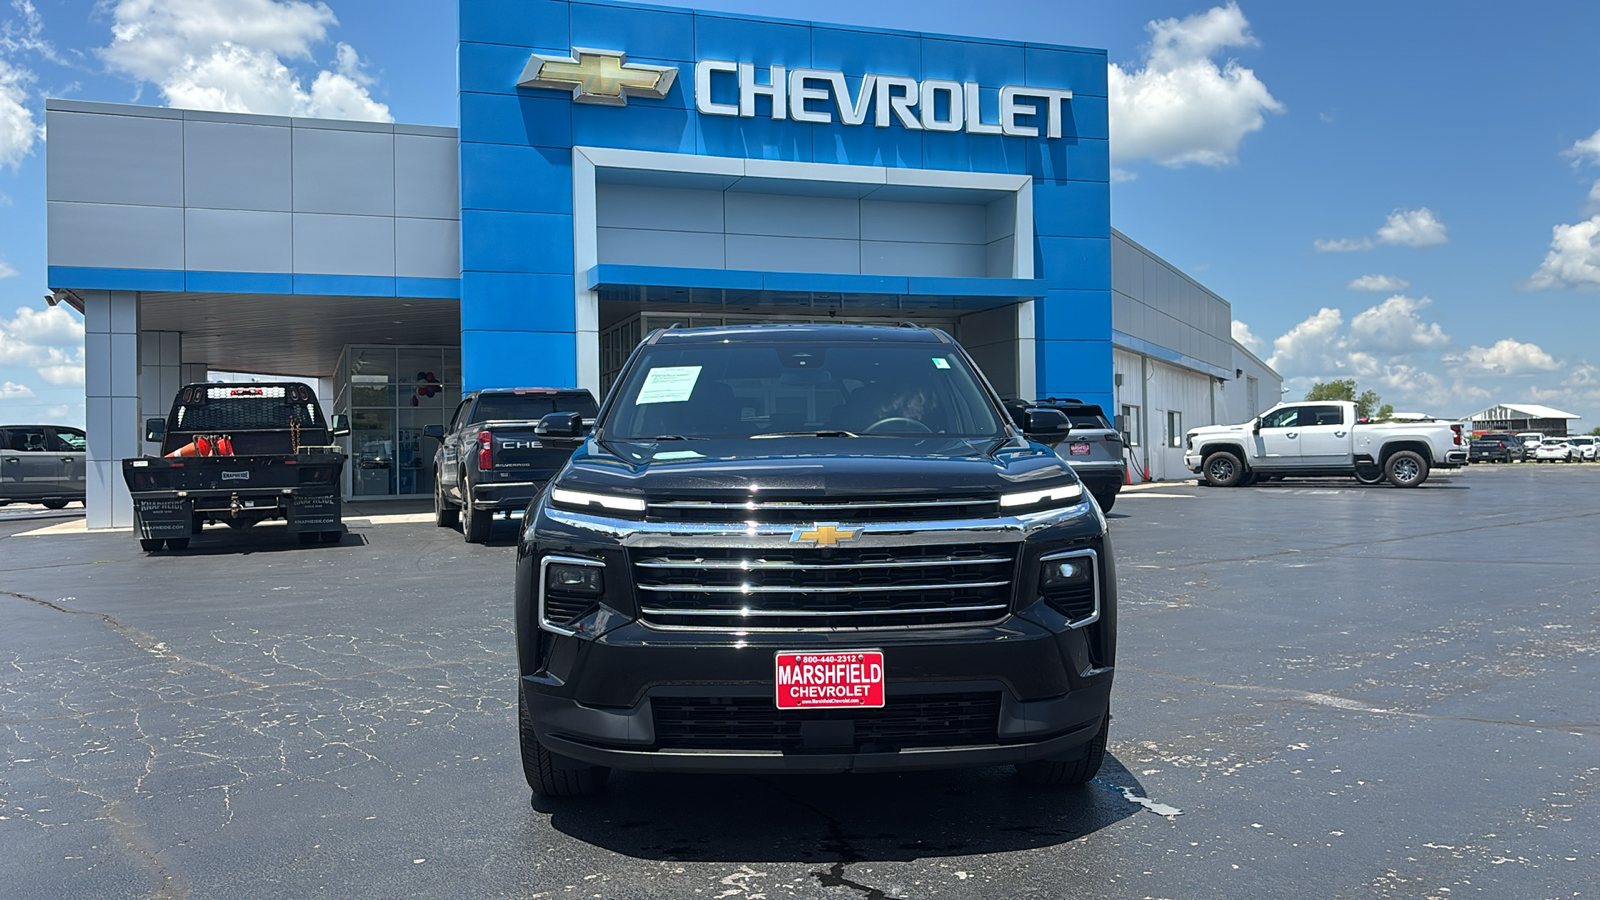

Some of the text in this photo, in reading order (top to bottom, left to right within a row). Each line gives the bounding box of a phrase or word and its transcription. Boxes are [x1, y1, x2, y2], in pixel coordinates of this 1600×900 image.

[695, 58, 1073, 139] CHEVROLET
[141, 500, 184, 511] KNAPHEIDE
[294, 495, 334, 505] KNAPHEIDE
[803, 655, 857, 663] 800-440-2312
[778, 663, 882, 685] MARSHFIELD
[790, 685, 870, 698] CHEVROLET
